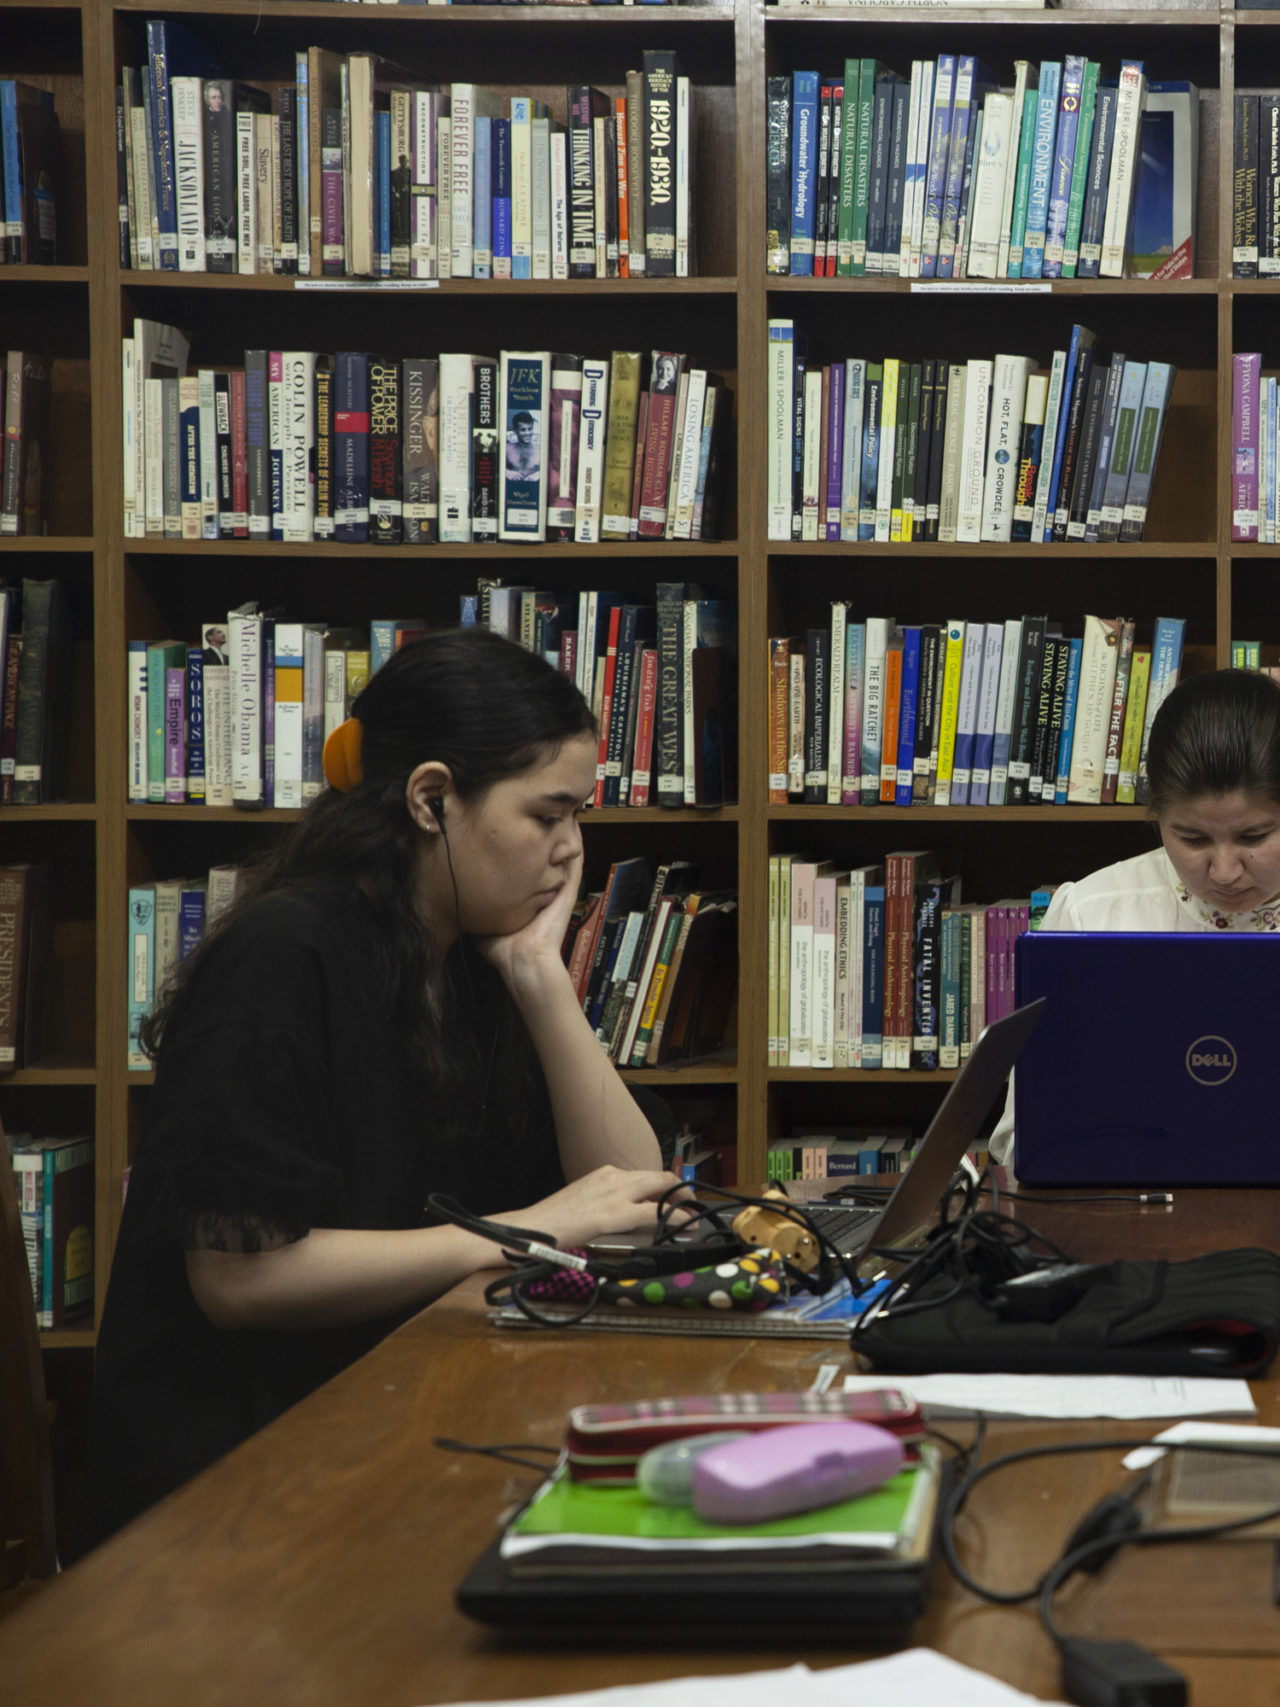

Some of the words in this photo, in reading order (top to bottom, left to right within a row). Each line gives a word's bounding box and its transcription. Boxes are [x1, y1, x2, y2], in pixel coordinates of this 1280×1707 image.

[397, 96, 406, 153] GETTYSBURG
[453, 99, 469, 156] FOREVER
[616, 112, 625, 145] Howard
[845, 103, 857, 152] NATURAL
[859, 102, 870, 151] NATURAL
[1098, 96, 1111, 152] Environmental
[1122, 91, 1133, 121] MILLER
[442, 133, 450, 175] FOREVER
[572, 128, 593, 186] THINKING
[617, 147, 625, 165] Zinn
[798, 109, 810, 168] Groundwater
[1032, 98, 1054, 208] ENVIRONMENT
[1116, 130, 1129, 181] SPOOLMAN
[178, 141, 199, 236] JACKSONLAND
[258, 148, 269, 184] Slavery
[442, 176, 450, 201] FREE
[453, 164, 469, 194] FREE
[842, 154, 854, 207] DISASTERS
[856, 154, 868, 207] DISASTERS
[1093, 154, 1105, 189] Sciences
[572, 190, 593, 205] IN
[618, 180, 626, 199] War
[795, 171, 809, 218] Hydrology
[498, 199, 506, 234] HOWARD
[572, 210, 593, 247] TIME
[498, 236, 506, 257] ZINN
[271, 362, 280, 378] MY
[510, 367, 541, 384] JFK
[776, 350, 784, 381] MILLER
[217, 392, 229, 433] BLOWBACK
[271, 385, 280, 445] AMERICAN
[293, 361, 305, 424] COLIN
[409, 370, 422, 454] KISSINGER
[480, 368, 491, 424] BROTHERS
[776, 388, 784, 440] SPOOLMAN
[868, 385, 878, 435] Environmental
[974, 366, 987, 445] UNCOMMON
[1001, 397, 1011, 419] HOT,
[687, 398, 699, 443] LOSING
[999, 421, 1010, 445] FLAT,
[865, 436, 876, 458] Policy
[271, 456, 280, 508] JOURNEY
[293, 434, 305, 512] POWELL
[680, 446, 694, 499] AMERICA
[970, 449, 982, 505] GROUND
[1015, 457, 1032, 505] Through
[1025, 465, 1037, 499] Break
[240, 622, 257, 692] Michelle
[662, 624, 677, 662] THE
[832, 620, 842, 662] EMERALD
[621, 653, 630, 712] LOUISIANA'S
[815, 658, 823, 714] ECOLOGICAL
[832, 663, 842, 694] REALM
[869, 665, 880, 682] THE
[1039, 643, 1054, 690] STAYING
[1054, 646, 1069, 692] STAYING
[1114, 671, 1126, 707] AFTER
[190, 662, 201, 741] SOROS
[662, 672, 677, 726] GREAT
[868, 685, 879, 699] BIG
[1037, 692, 1049, 726] ALIVE
[1051, 695, 1063, 729] ALIVE
[169, 698, 181, 745] Empire
[240, 698, 257, 756] Obama
[815, 716, 823, 770] IMPERIALISM
[867, 702, 879, 742] RATCHET
[1110, 710, 1121, 731] THE
[886, 931, 896, 961] Physical
[901, 931, 910, 961] Physical
[884, 963, 895, 1018] Anthropology
[898, 963, 909, 1018] Anthropology
[1192, 1053, 1231, 1067] DELL
[829, 1161, 856, 1171] Bernard
